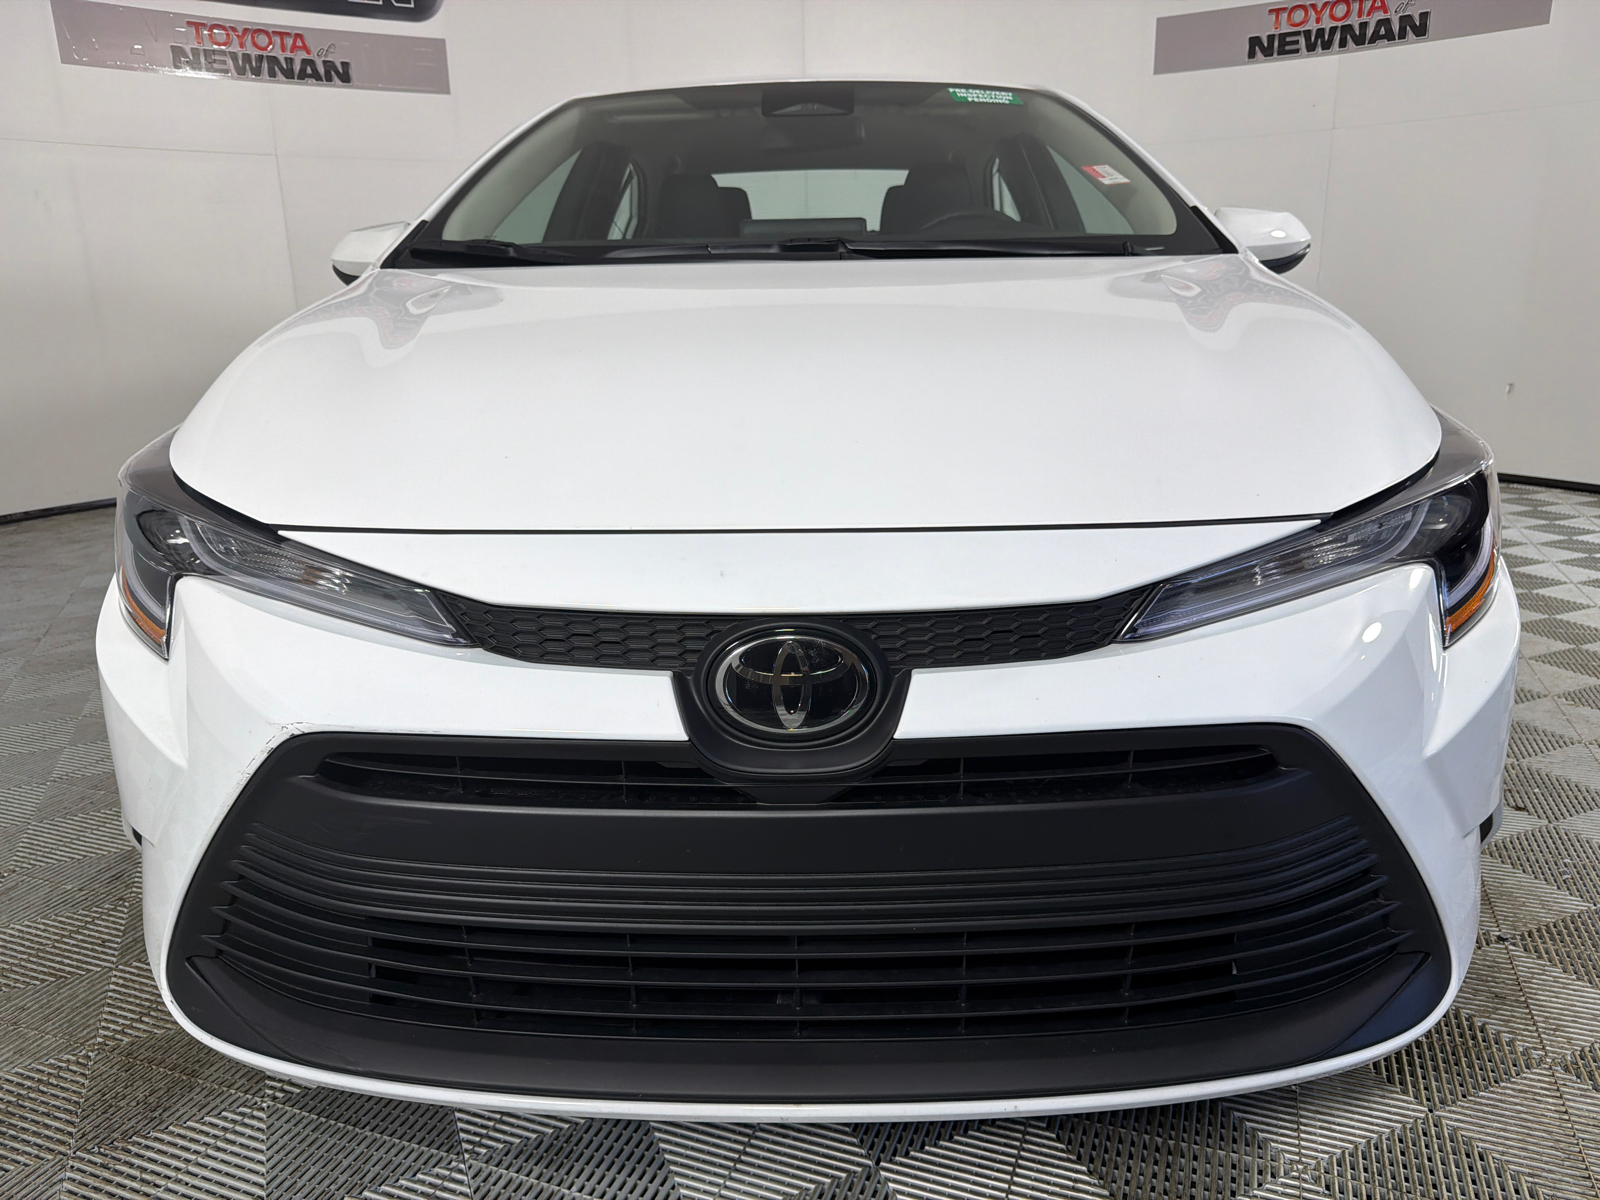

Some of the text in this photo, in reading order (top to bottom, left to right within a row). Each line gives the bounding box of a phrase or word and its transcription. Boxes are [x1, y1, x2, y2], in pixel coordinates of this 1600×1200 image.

[1268, 0, 1415, 30] TOYOTA of
[186, 20, 336, 58] TOYOTA of
[1247, 11, 1430, 59] NEWNAN
[169, 44, 351, 84] NEWNAN
